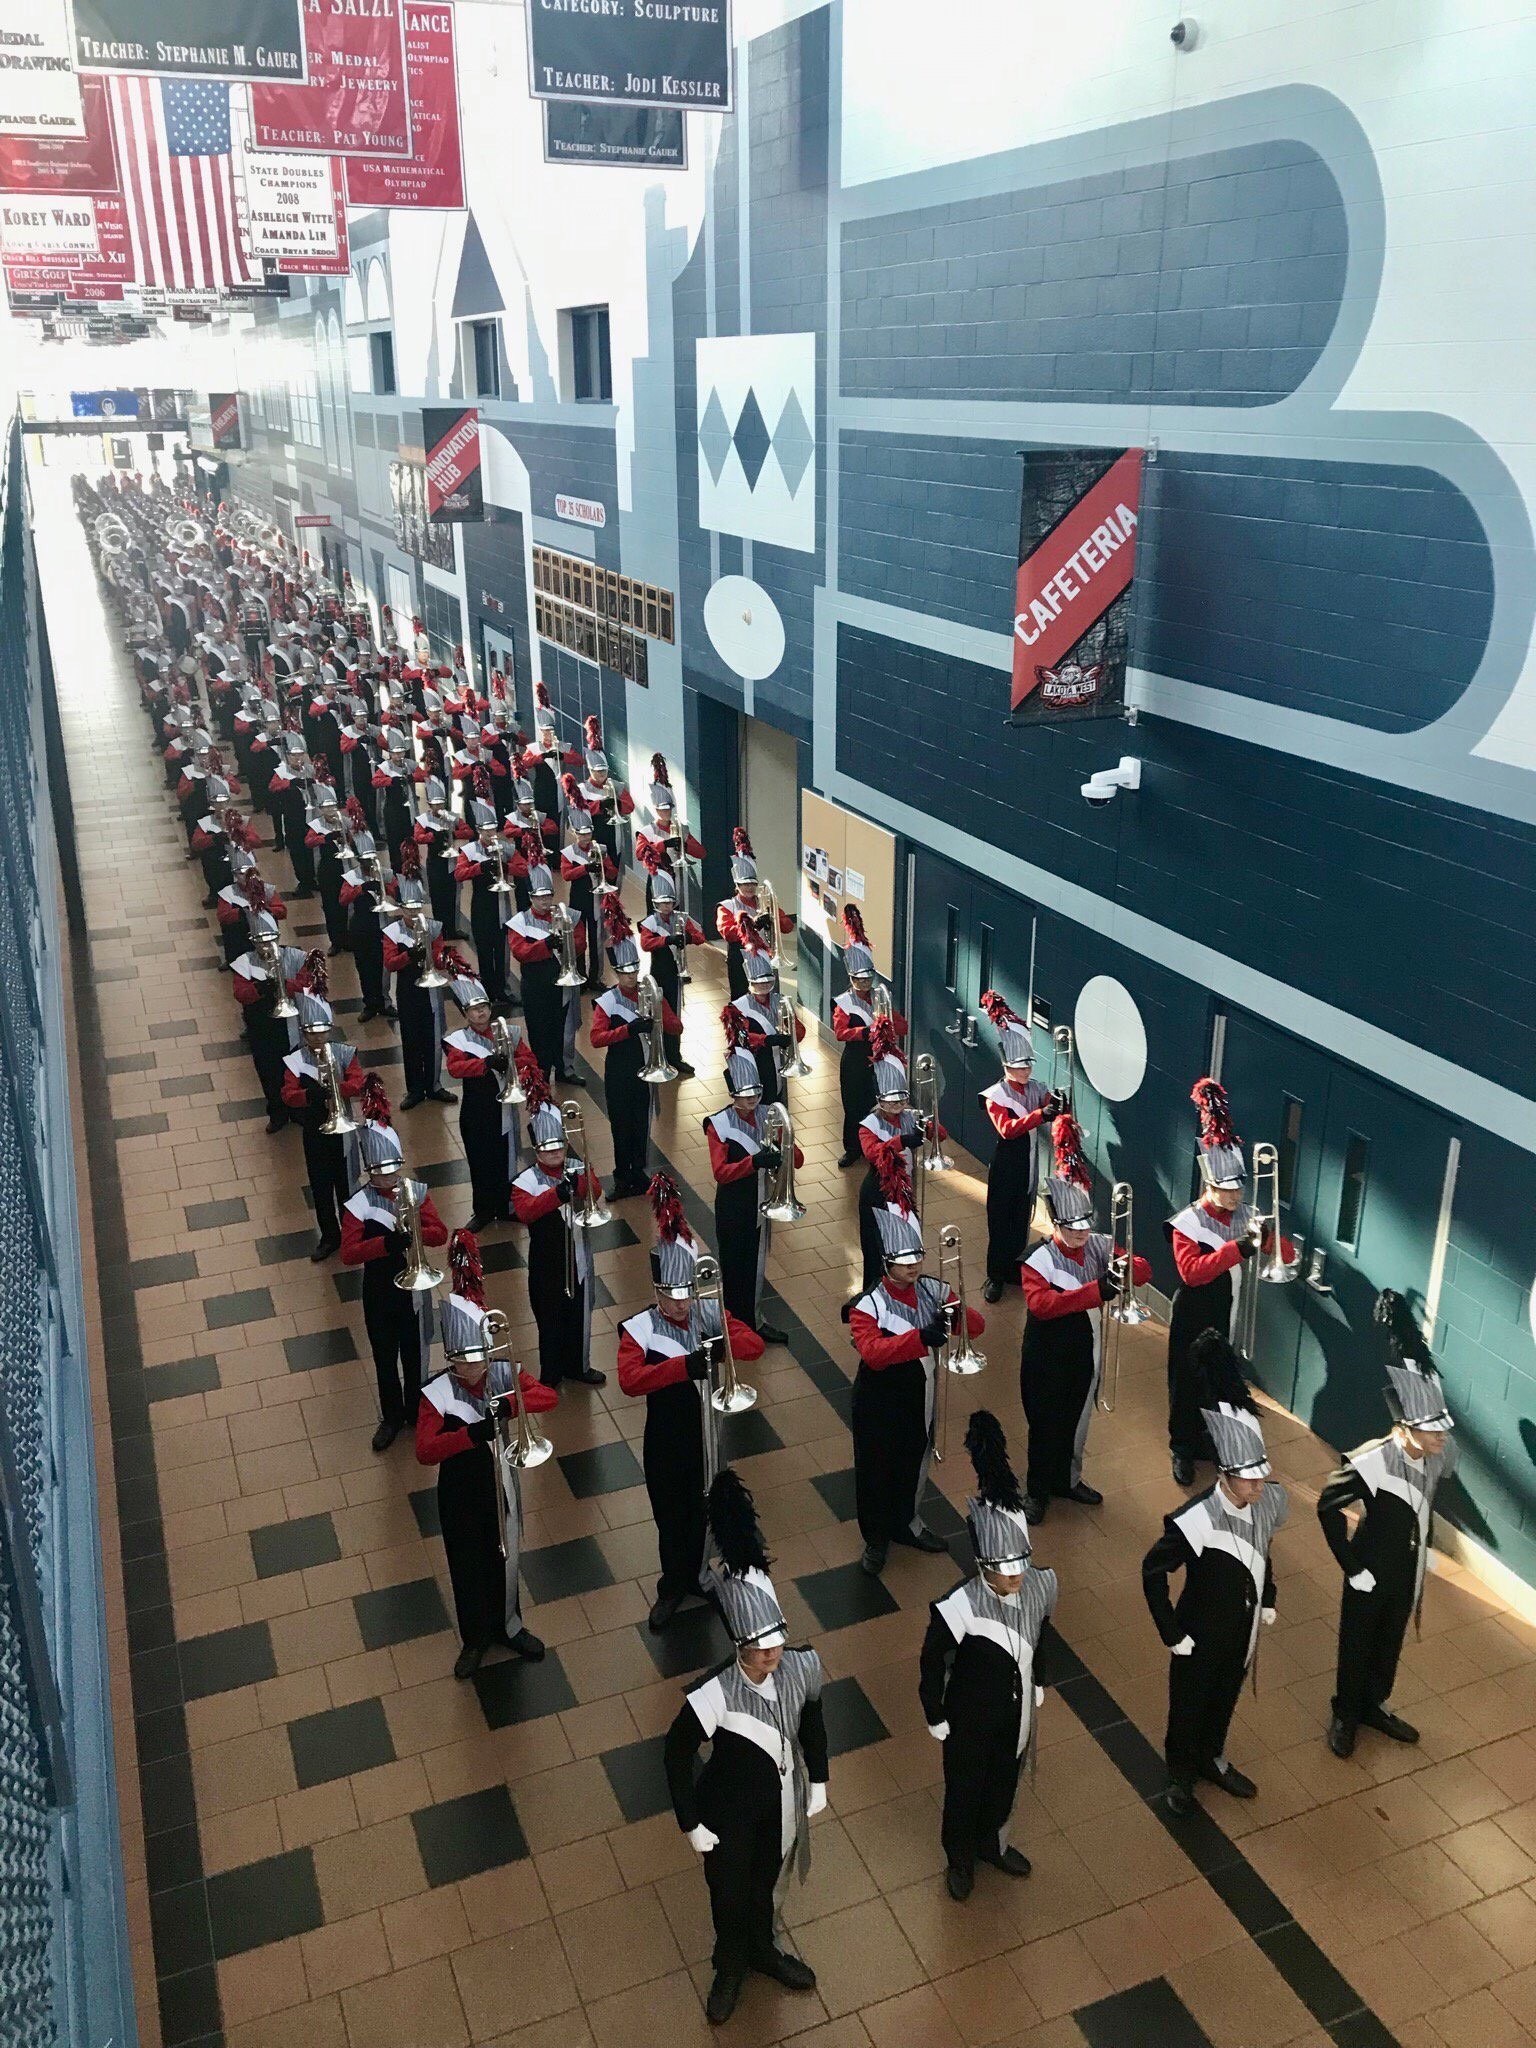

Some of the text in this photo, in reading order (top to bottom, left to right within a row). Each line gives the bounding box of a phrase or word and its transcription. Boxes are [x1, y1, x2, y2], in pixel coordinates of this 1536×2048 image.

[541, 0, 719, 23] CATEGORY: SCULPTURE
[81, 36, 298, 69] TEACHER: STEPHANIE M. GAUER
[407, 41, 429, 50] ALIST
[331, 51, 379, 67] MEDAL
[407, 53, 449, 64] OLYMPIAD
[340, 75, 398, 91] JEWELRY
[543, 66, 720, 98] TEACHER: JODI KESSLER
[0, 114, 37, 125] PHANIE
[411, 112, 441, 121] ATICAL
[260, 125, 403, 148] TEACHER: PAT YOUNG
[554, 139, 678, 157] TEACHER: STEPHANIE GAUER
[250, 165, 324, 178] STATE DOUBLES
[363, 164, 445, 176] USA MATHEMATICAL
[260, 178, 317, 189] CHAMPIONS
[384, 178, 427, 188] OLYMPIAD
[276, 192, 300, 205] 2008
[395, 191, 418, 200] 2010
[3, 208, 91, 227] KOREY WARD
[251, 210, 299, 223] ASHLEIGH
[302, 212, 334, 224] WITTE
[262, 227, 306, 241] AMANDA
[309, 229, 327, 241] LIN
[254, 246, 280, 255] COACH
[13, 269, 66, 280] GIRLS GOLF
[84, 288, 106, 298] 2006
[425, 417, 478, 481] INNOVATION
[433, 463, 461, 493] HUB
[557, 498, 566, 514] TOP
[575, 502, 604, 523] SCHOLARS
[1014, 502, 1138, 646] CAFETERIA
[1044, 683, 1074, 696] LAKOTA
[1076, 680, 1095, 693] WEST
